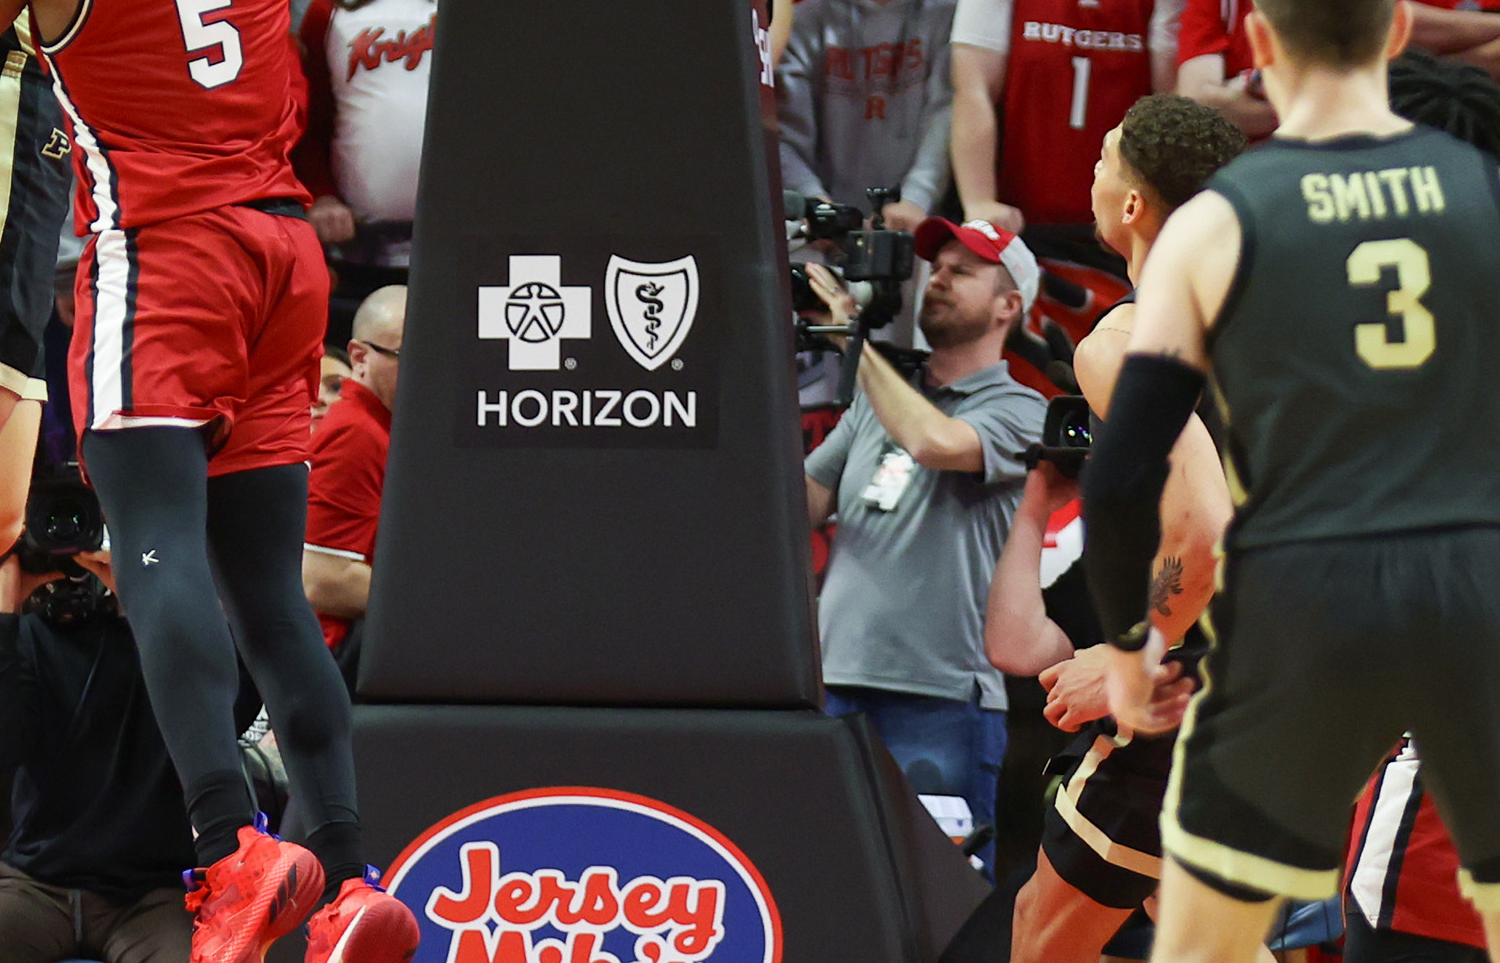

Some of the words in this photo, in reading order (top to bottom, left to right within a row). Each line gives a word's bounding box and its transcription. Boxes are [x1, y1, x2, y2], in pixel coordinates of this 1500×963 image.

[1022, 21, 1143, 52] RUTGERS
[1067, 56, 1089, 129] 1
[41, 127, 72, 159] P
[1301, 164, 1446, 223] SMITH
[1346, 238, 1438, 370] 3
[477, 389, 697, 428] HORIZON
[429, 844, 722, 957] Jersey
